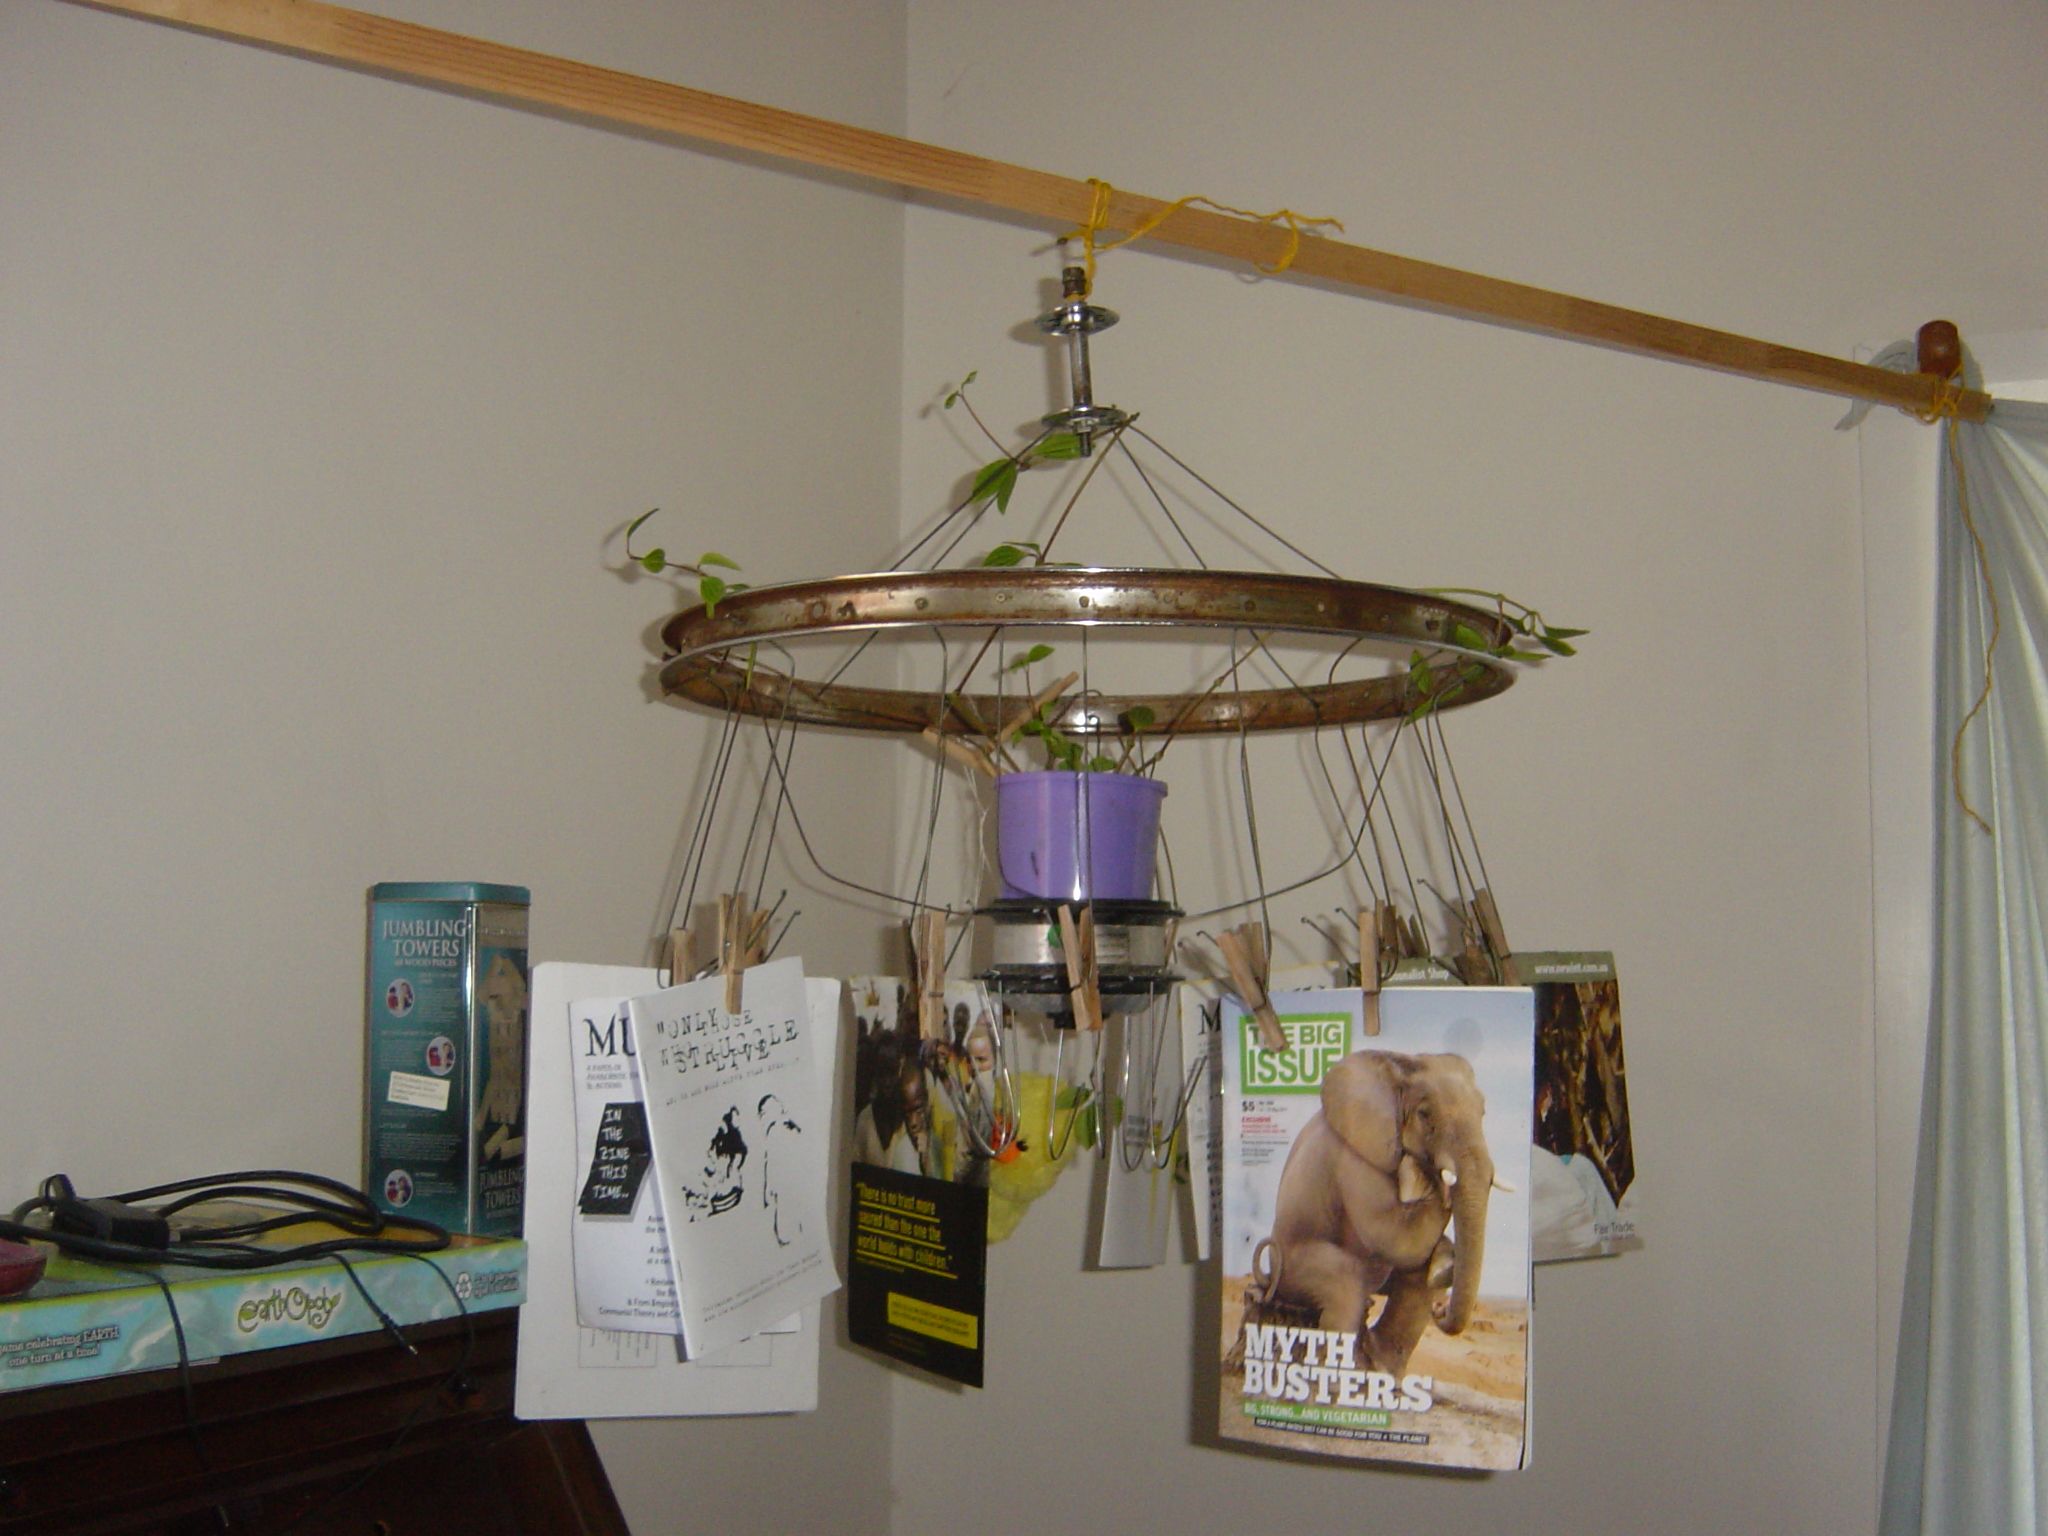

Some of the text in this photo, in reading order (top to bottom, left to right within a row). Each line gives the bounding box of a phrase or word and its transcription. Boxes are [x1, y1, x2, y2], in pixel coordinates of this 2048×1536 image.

[383, 919, 466, 939] JUMBLING
[393, 939, 460, 957] TOWERS
[1248, 1023, 1342, 1046] TE BIG
[1242, 1100, 1256, 1112] $5
[604, 1109, 622, 1122] IN
[601, 1126, 624, 1141] THE
[600, 1146, 630, 1160] ZINE
[600, 1164, 628, 1179] THIS
[1244, 1322, 1358, 1369] MYTH
[1242, 1358, 1433, 1413] BUSTERS
[1322, 1410, 1388, 1426] VEGETARIAN
[1402, 1434, 1427, 1444] PLANET
